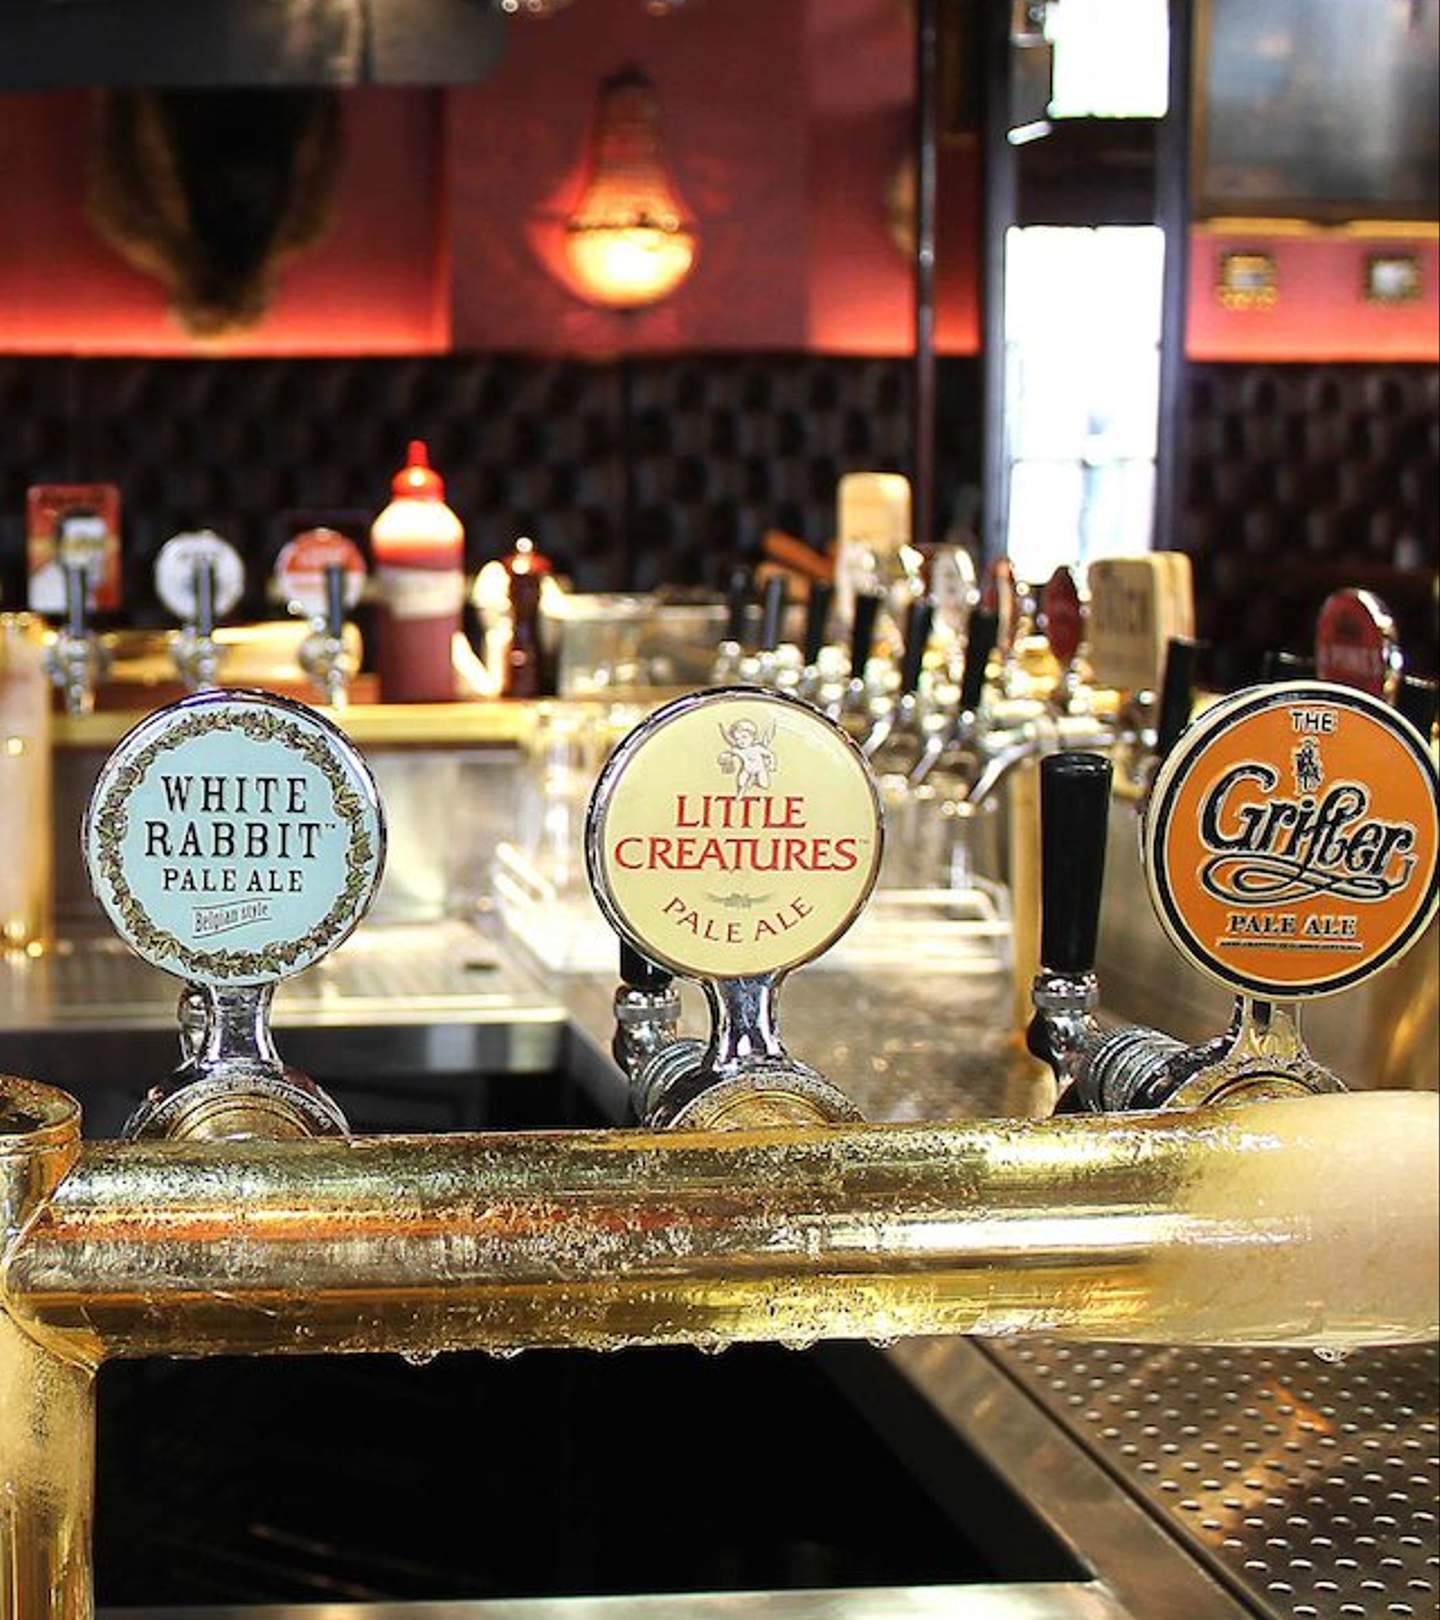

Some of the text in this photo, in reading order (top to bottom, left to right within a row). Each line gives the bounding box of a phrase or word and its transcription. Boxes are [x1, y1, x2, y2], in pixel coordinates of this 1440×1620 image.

[1291, 711, 1334, 733] THE
[161, 776, 307, 814] WHITE
[676, 795, 807, 829] LITTLE
[1200, 763, 1417, 908] Grifter
[163, 868, 303, 893] PALE ALE
[662, 896, 814, 943] PALE ALE
[1228, 914, 1357, 936] PALE ALE
